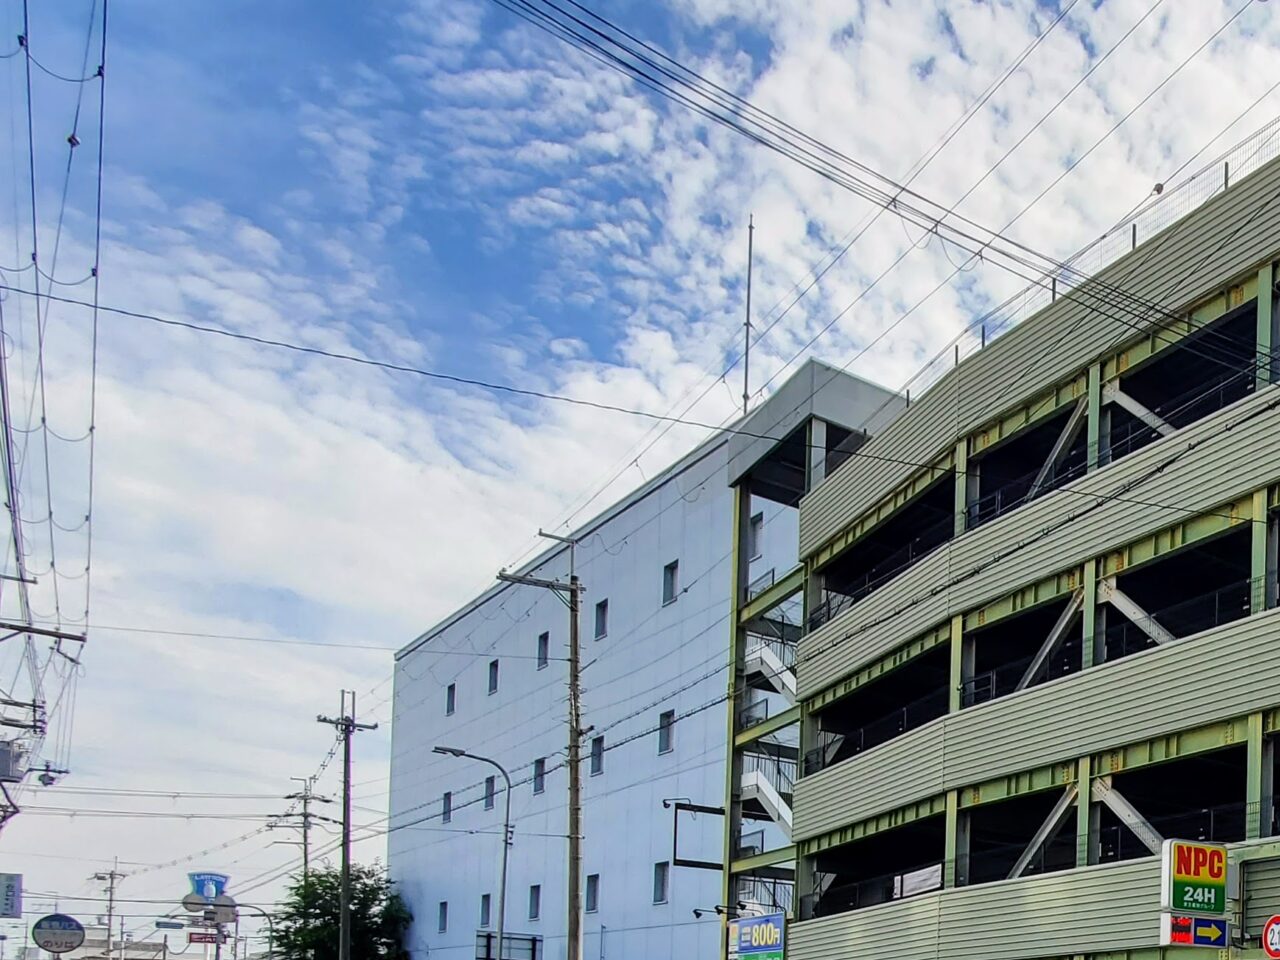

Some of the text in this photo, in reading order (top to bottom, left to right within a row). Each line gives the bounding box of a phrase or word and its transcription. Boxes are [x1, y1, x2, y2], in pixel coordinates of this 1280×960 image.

[1176, 844, 1223, 878] NPC
[1183, 886, 1216, 904] 24H
[43, 940, 74, 948] のりば
[752, 922, 780, 947] 800円
